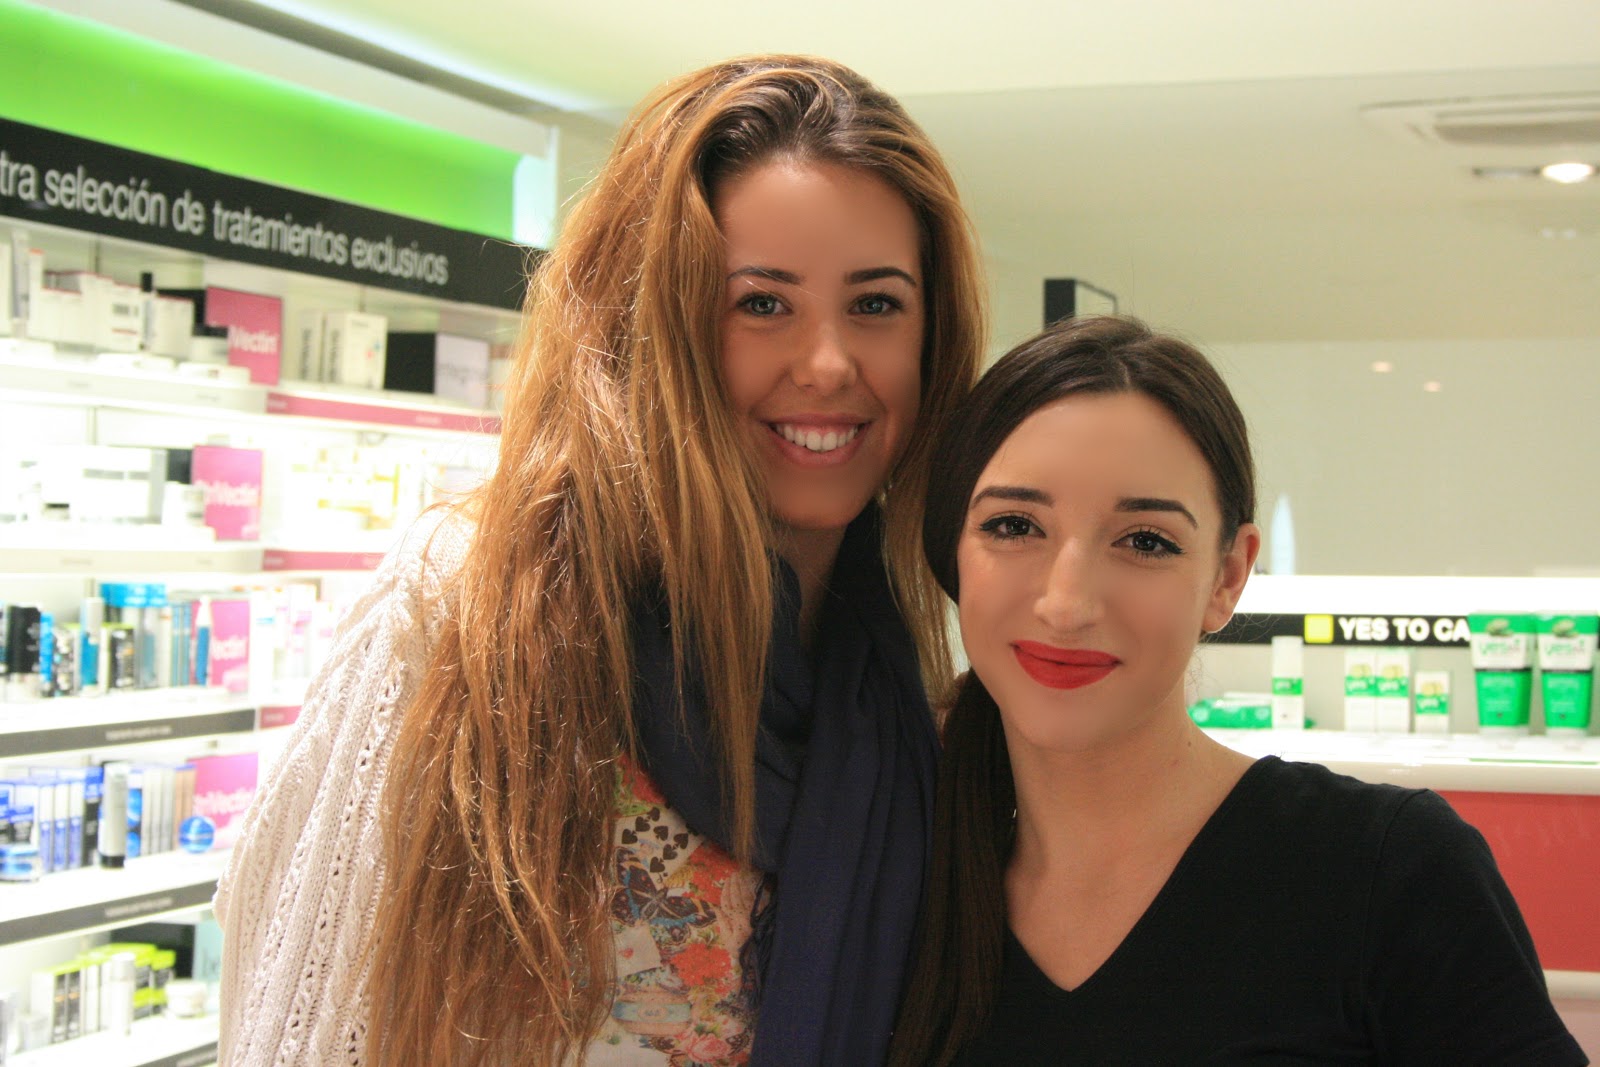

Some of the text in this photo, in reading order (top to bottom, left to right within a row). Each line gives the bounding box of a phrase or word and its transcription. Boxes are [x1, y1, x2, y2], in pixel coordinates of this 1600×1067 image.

[0, 150, 449, 285] tra selección de tratamientos exclusivos
[1338, 616, 1390, 642] YES
[1392, 617, 1430, 642] TO
